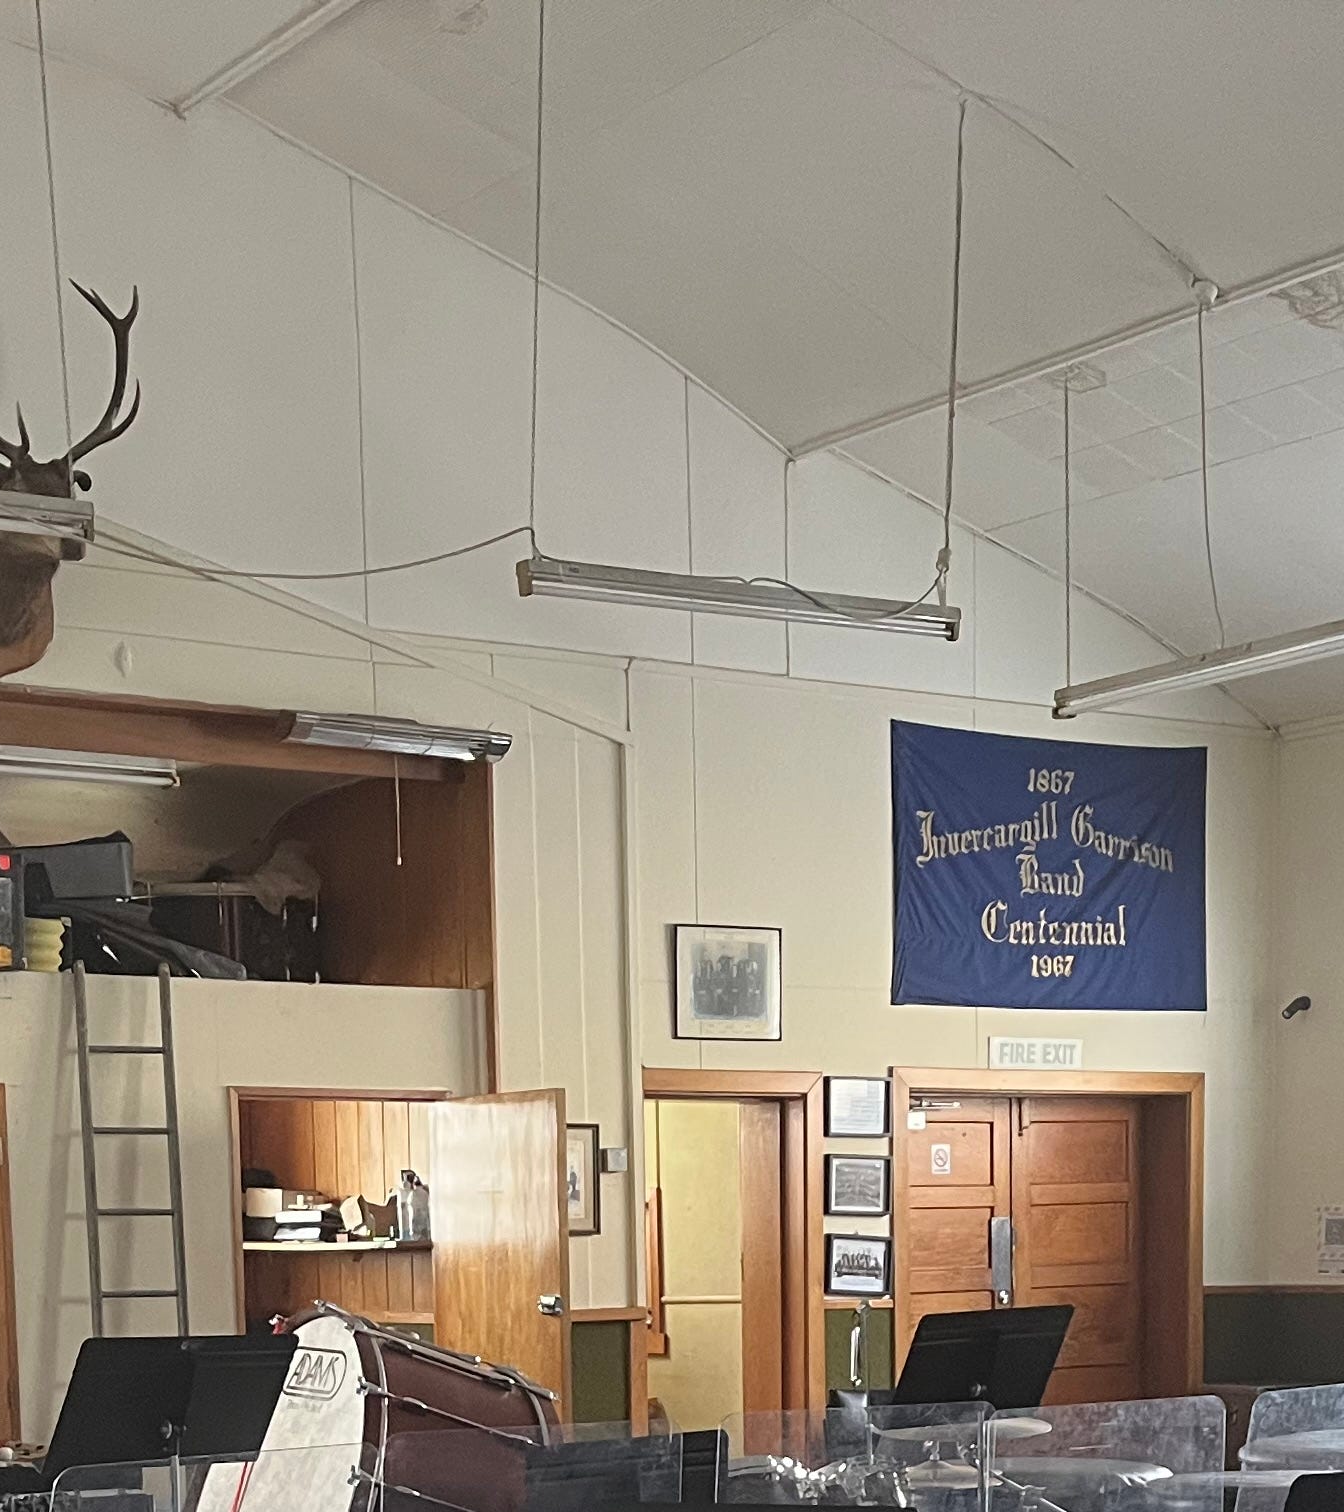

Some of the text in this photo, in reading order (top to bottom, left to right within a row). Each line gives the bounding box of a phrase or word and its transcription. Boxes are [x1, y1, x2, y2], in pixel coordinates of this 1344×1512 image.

[1027, 768, 1075, 795] 1867
[915, 800, 1174, 873] Invercargill Garrison
[1016, 850, 1085, 898] Band
[981, 900, 1126, 947] Centennial
[1030, 954, 1074, 978] 1967
[998, 1042, 1077, 1065] FIRE EXIT
[287, 1352, 340, 1393] ADAMS
